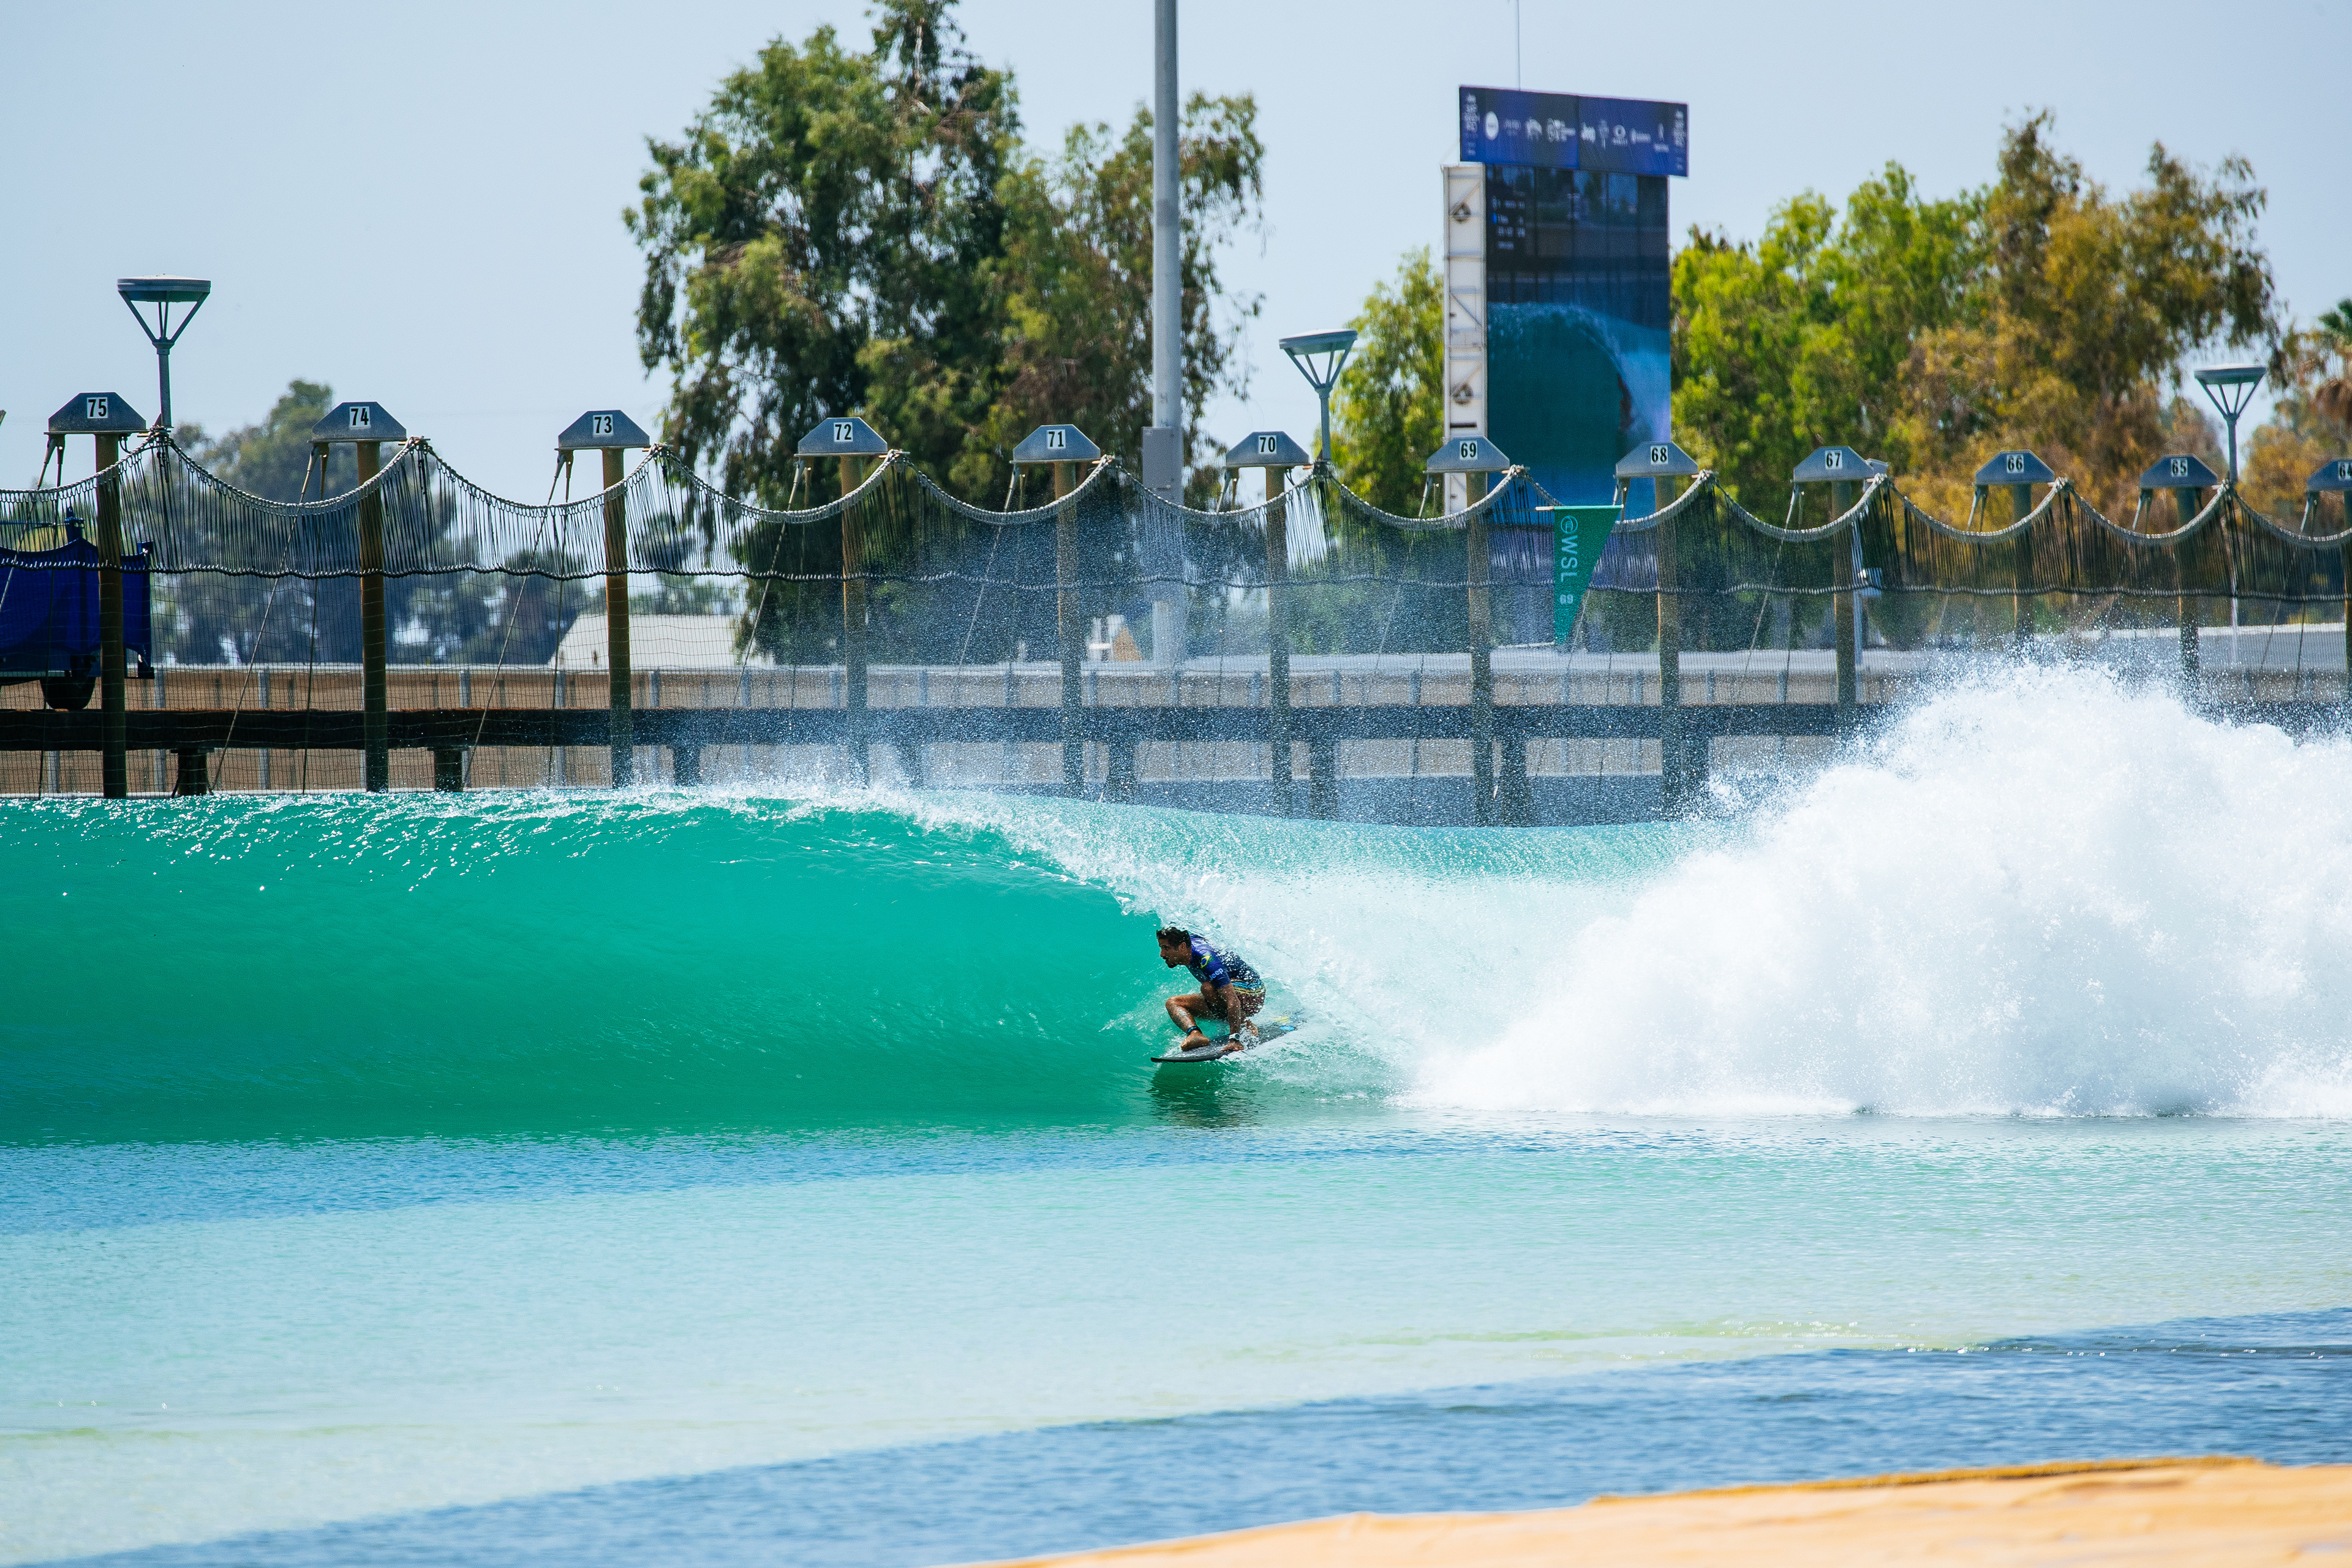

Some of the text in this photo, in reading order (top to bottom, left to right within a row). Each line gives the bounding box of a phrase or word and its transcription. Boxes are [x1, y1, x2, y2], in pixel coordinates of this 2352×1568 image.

[88, 399, 107, 417] 75
[351, 408, 369, 426] 74
[595, 416, 612, 434] 73
[835, 424, 852, 440] 72
[1049, 431, 1065, 447] 71
[1260, 437, 1276, 453] 70
[1461, 443, 1477, 458] 69
[1652, 448, 1667, 462] 68
[1826, 451, 1841, 467] 67
[2008, 456, 2024, 471] 66
[2172, 458, 2187, 474] 65
[1208, 968, 1224, 981] Jeep
